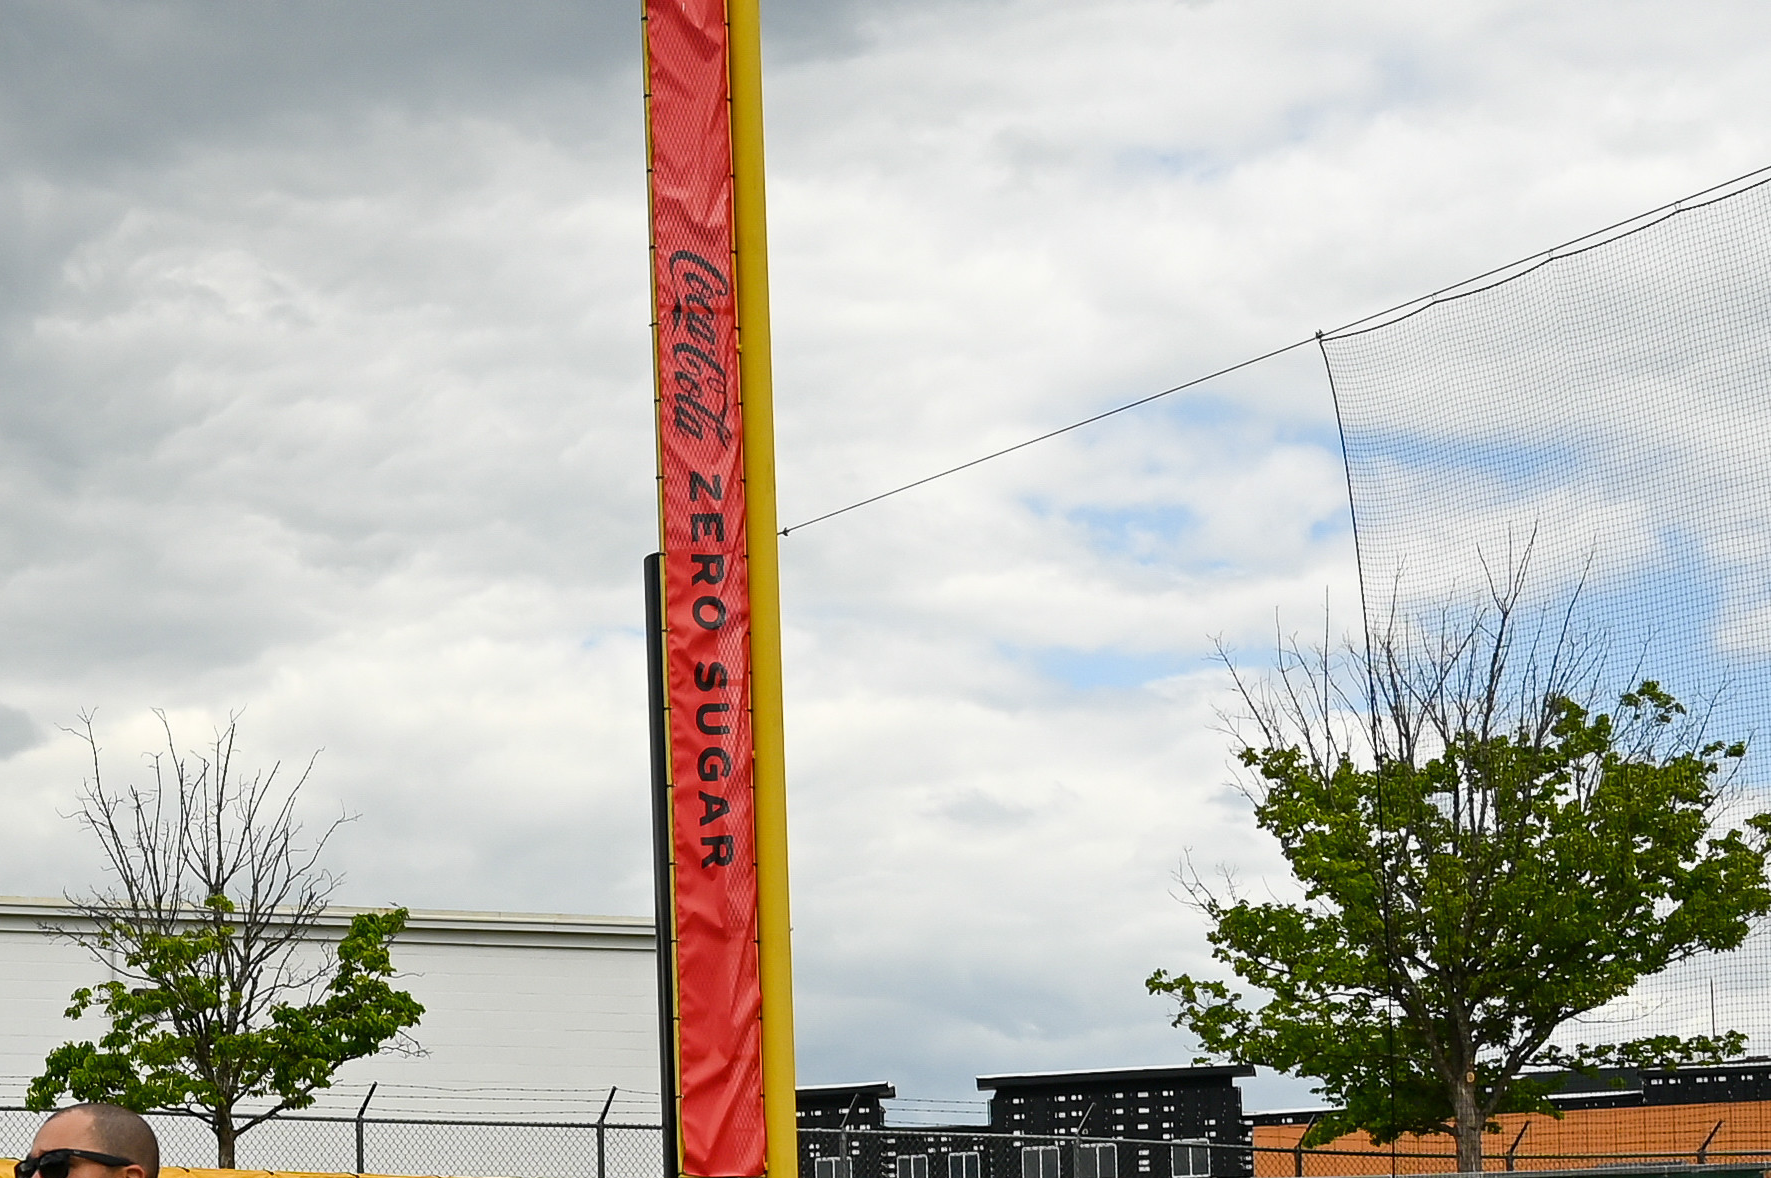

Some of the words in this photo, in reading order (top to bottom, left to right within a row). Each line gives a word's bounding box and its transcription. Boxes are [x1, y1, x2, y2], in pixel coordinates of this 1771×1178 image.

[669, 250, 732, 450] Coca-Cola
[688, 470, 727, 631] ZERO
[693, 661, 734, 869] SUGAR
